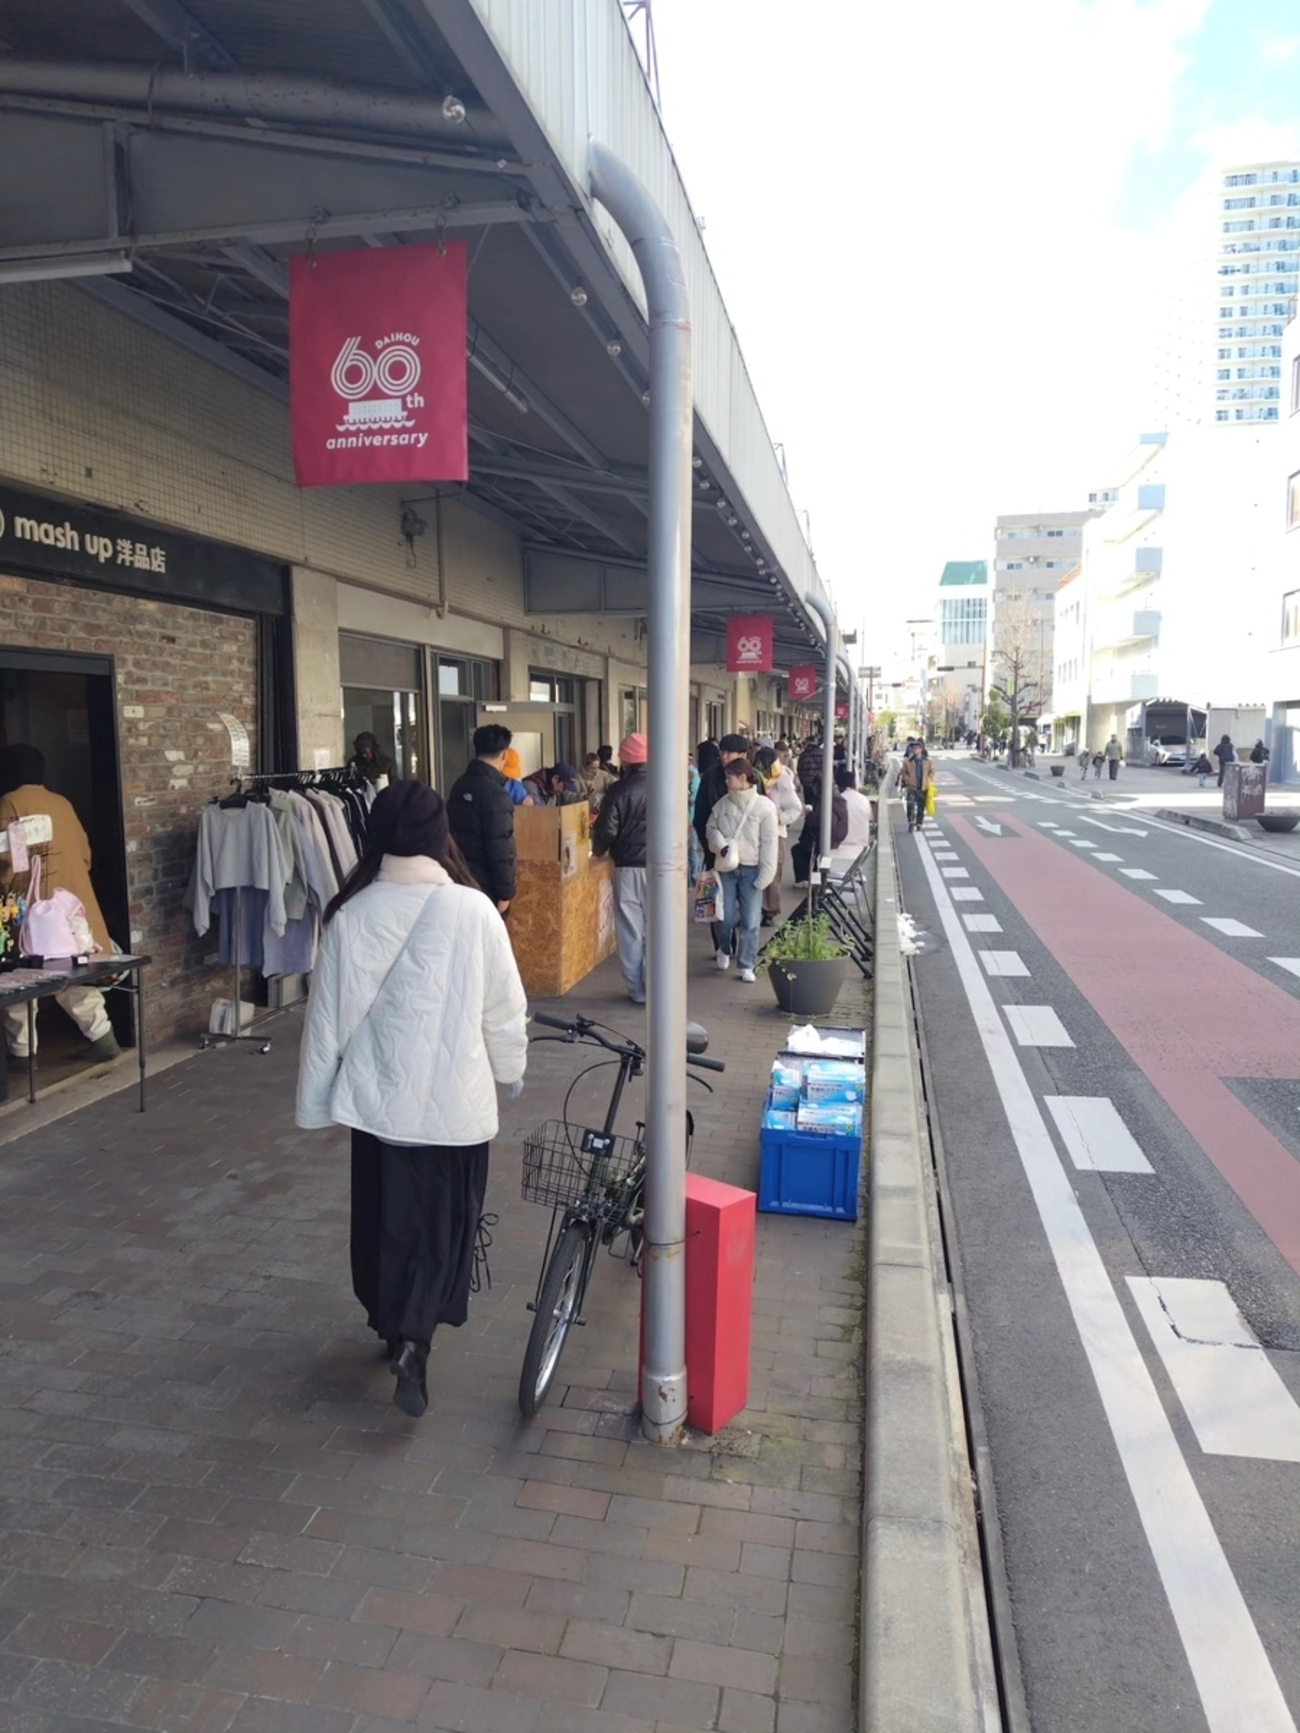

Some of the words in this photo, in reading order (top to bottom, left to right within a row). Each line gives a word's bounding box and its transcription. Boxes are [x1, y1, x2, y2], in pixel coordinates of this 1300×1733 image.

[375, 332, 420, 349] DAIHOU
[326, 432, 429, 449] anniversary
[14, 516, 80, 551] mash
[84, 533, 113, 563] up
[116, 538, 166, 574] 洋品店
